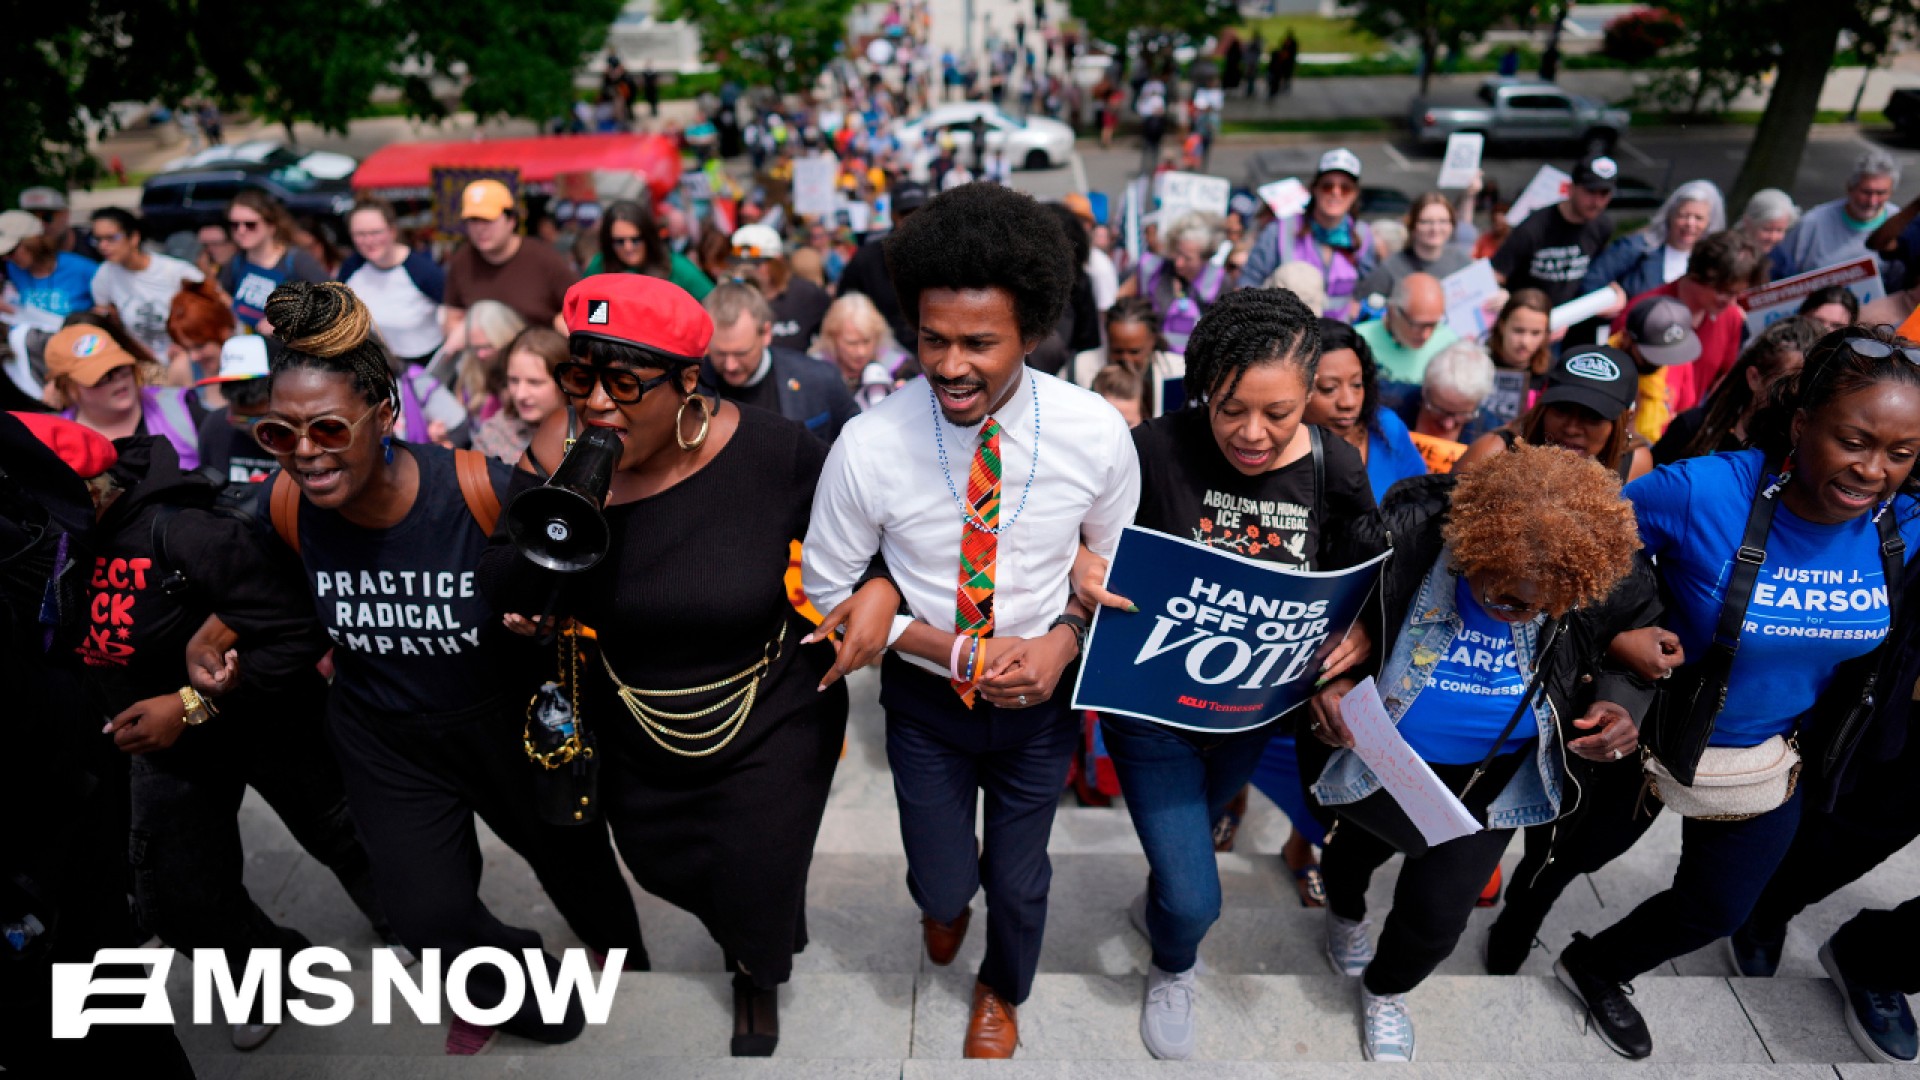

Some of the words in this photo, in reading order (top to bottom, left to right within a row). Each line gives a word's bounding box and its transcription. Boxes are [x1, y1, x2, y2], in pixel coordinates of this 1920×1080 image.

[1203, 489, 1259, 515] ABOLISH
[1260, 501, 1276, 514] NO
[1277, 501, 1311, 518] HUMAN
[1215, 508, 1242, 528] ICE
[1260, 515, 1272, 528] IS
[1272, 516, 1309, 531] ILLEGAL
[91, 556, 152, 590] ECT
[316, 570, 475, 598] PRACTICE
[1772, 566, 1844, 584] JUSTIN
[1847, 569, 1864, 583] J.
[90, 592, 136, 626] CK
[1188, 577, 1330, 621] HANDS
[1753, 582, 1889, 612] EARSON
[335, 601, 461, 630] RADICAL
[1166, 596, 1249, 632] OFF
[1256, 618, 1330, 641] OUR
[1806, 616, 1824, 625] for
[1457, 629, 1509, 650] USTIN
[1763, 624, 1890, 641] CONGRESSMA
[1134, 614, 1329, 690] VOTE
[1177, 695, 1208, 709] ACLU
[1208, 700, 1264, 713] Tennessee
